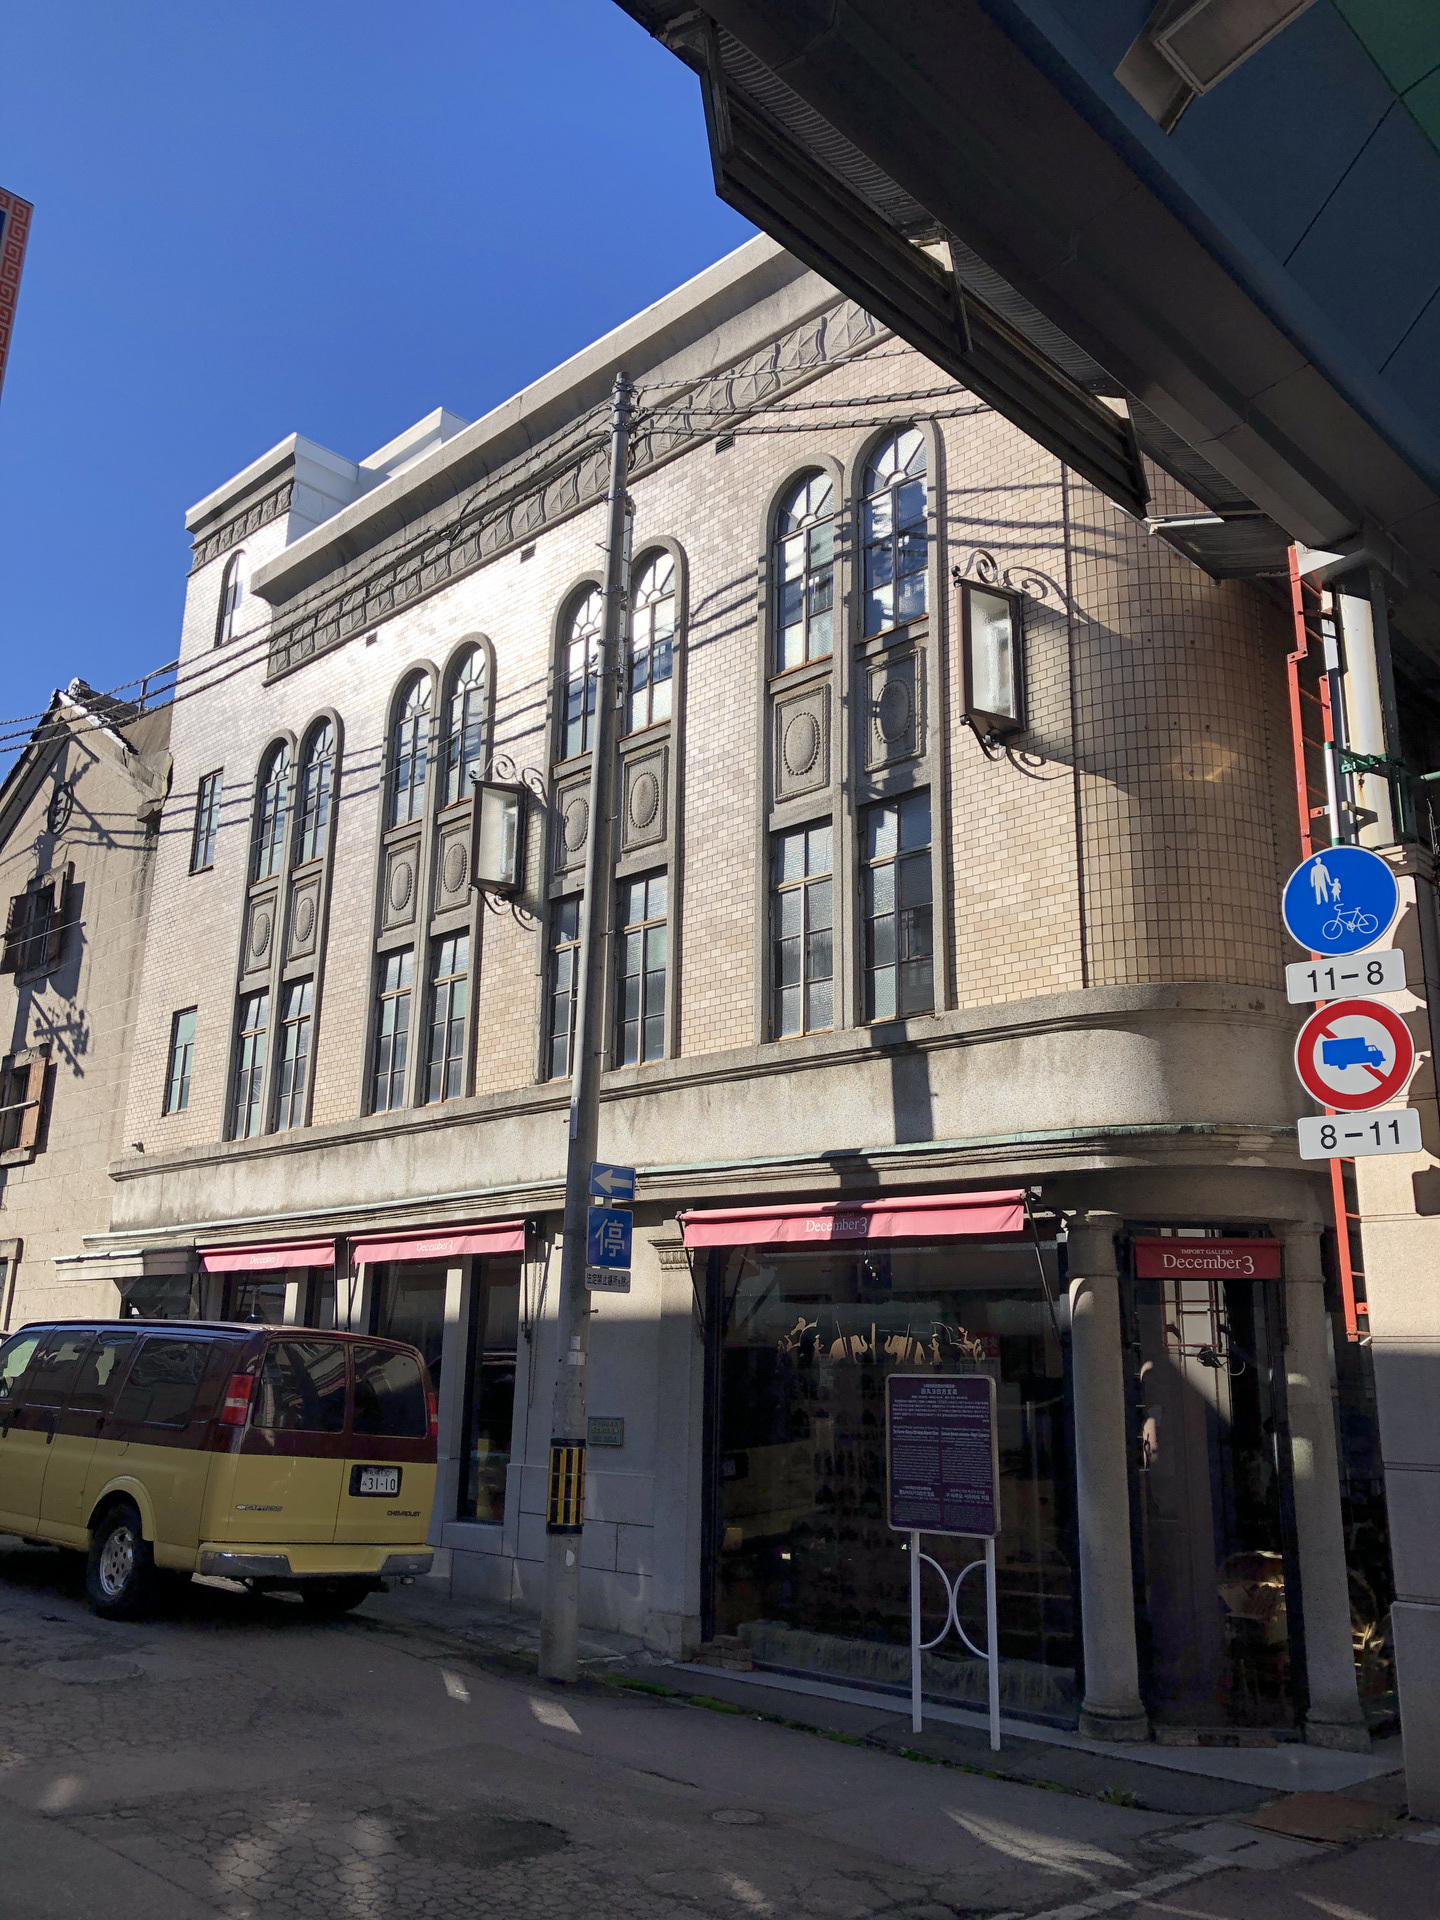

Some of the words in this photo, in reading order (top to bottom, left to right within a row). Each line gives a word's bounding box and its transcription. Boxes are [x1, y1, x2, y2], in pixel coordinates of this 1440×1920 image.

[1306, 960, 1385, 993] 11-8
[1320, 1119, 1400, 1150] 8-11
[595, 1218, 625, 1258] 停
[1205, 1248, 1234, 1256] GALLERY
